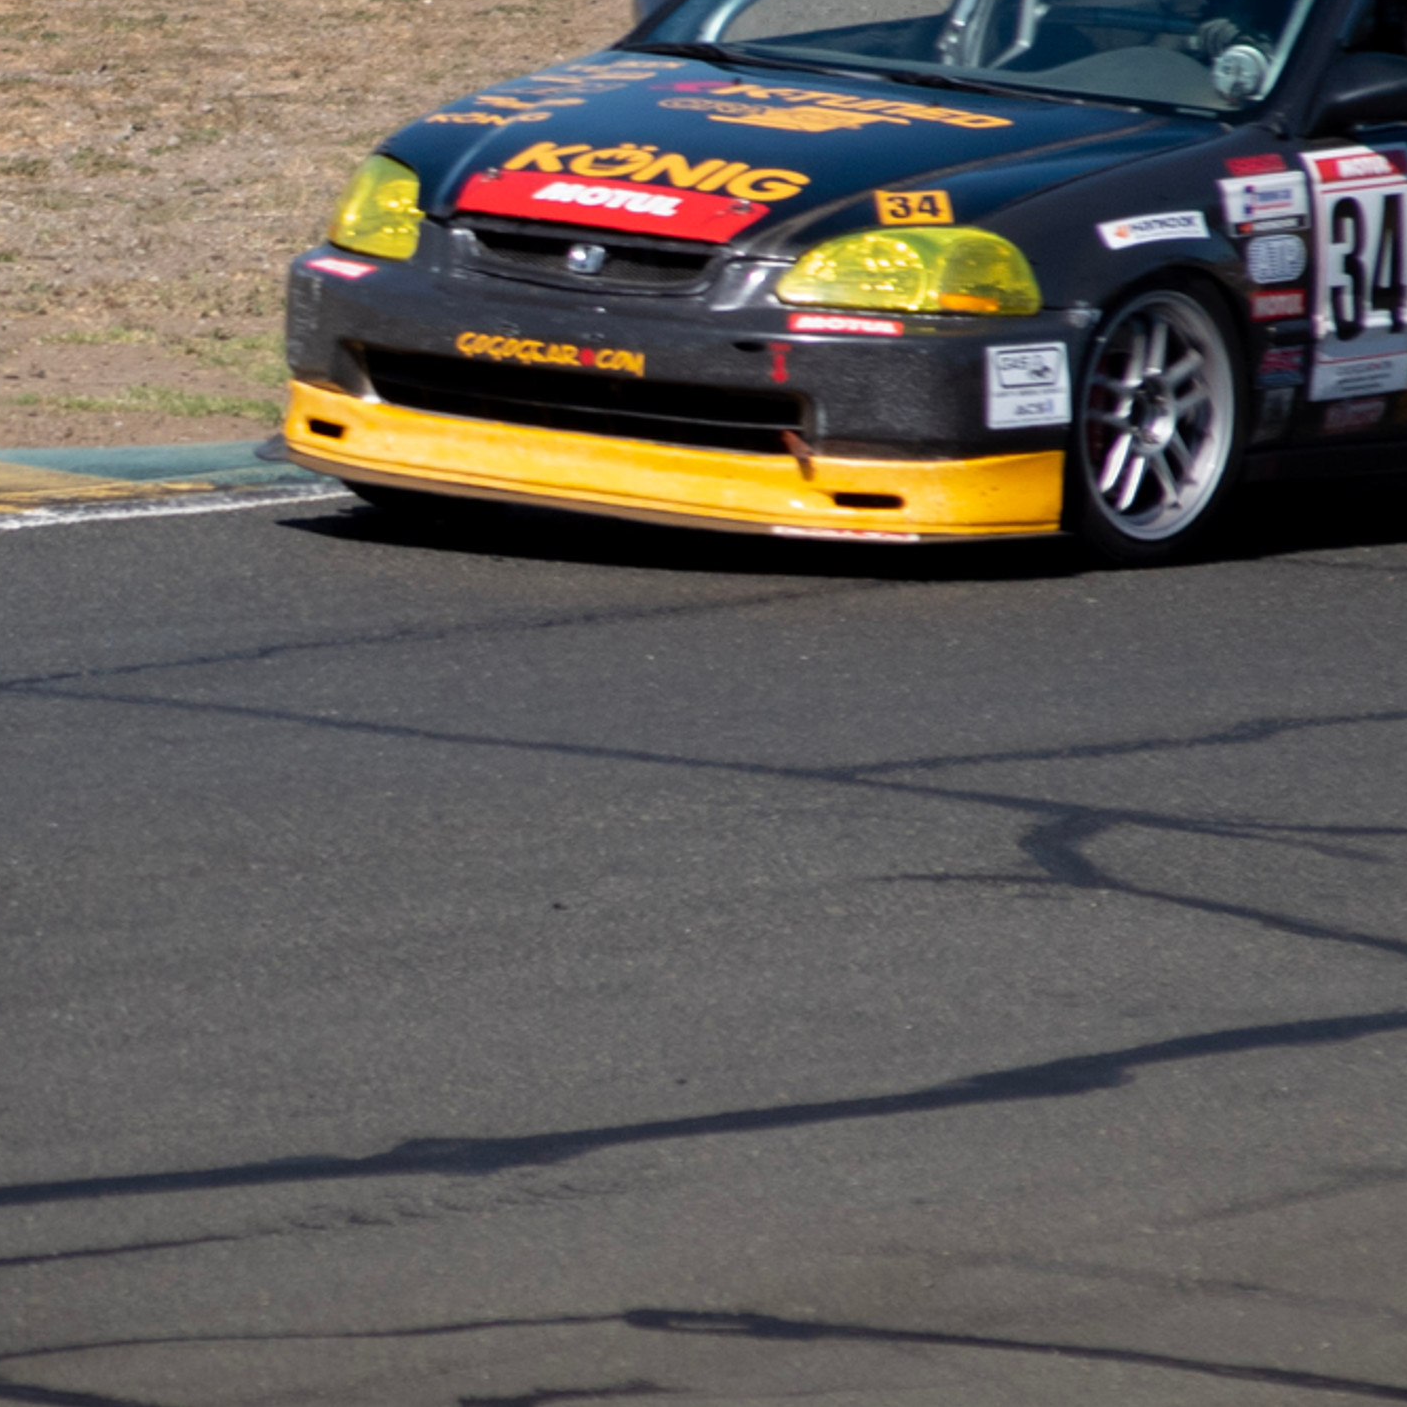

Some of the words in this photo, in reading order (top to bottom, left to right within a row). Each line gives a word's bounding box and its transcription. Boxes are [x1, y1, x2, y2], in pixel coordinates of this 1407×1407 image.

[532, 182, 683, 217] MOTUL
[888, 194, 942, 219] 34
[1331, 192, 1407, 340] 34
